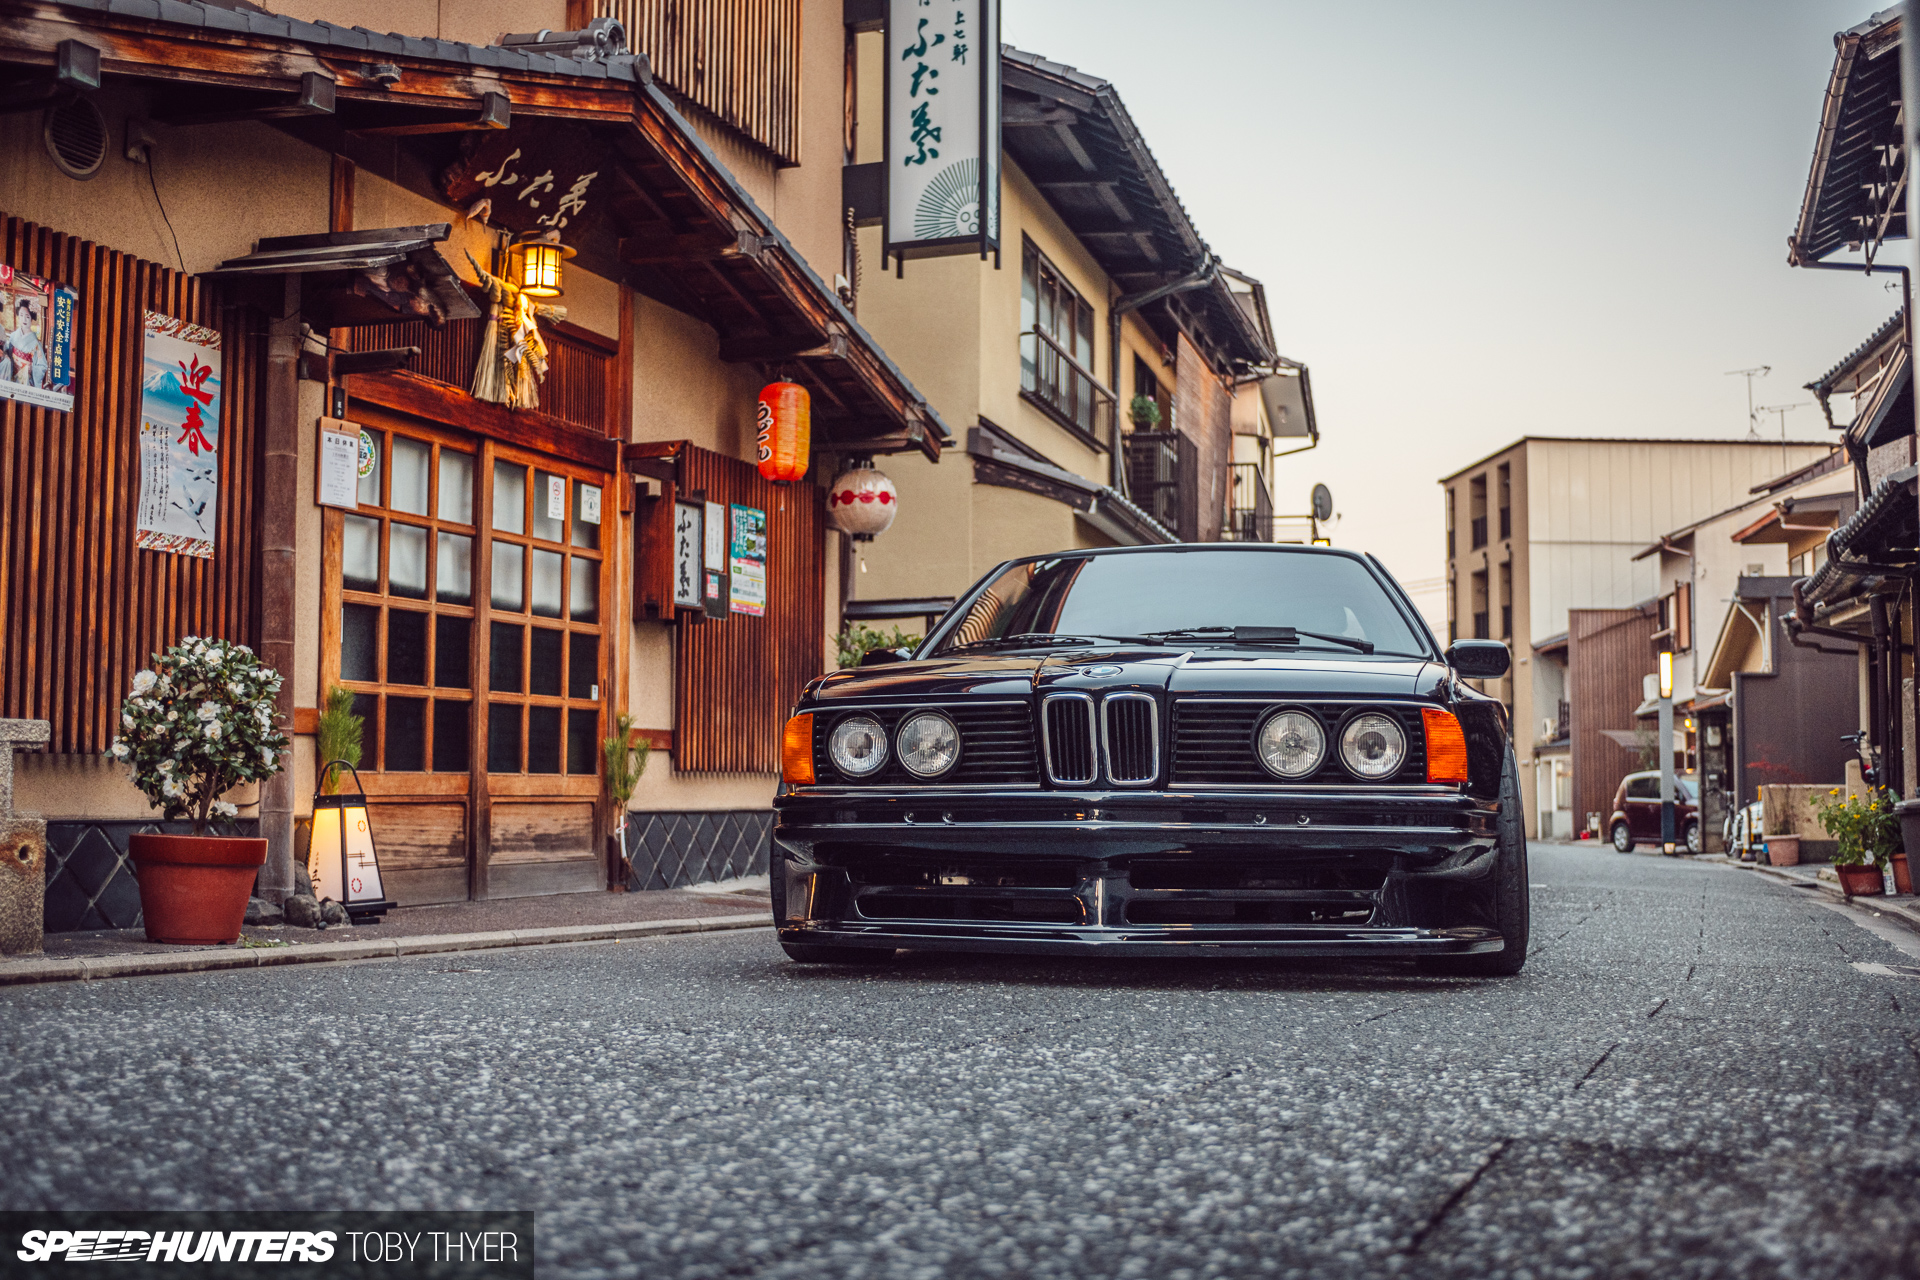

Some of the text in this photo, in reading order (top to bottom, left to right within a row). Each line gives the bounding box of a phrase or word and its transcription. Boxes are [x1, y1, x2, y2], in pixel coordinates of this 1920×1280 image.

[951, 11, 968, 65] 上七軒
[54, 296, 66, 378] 安心安全点検日
[177, 352, 215, 457] 迎春
